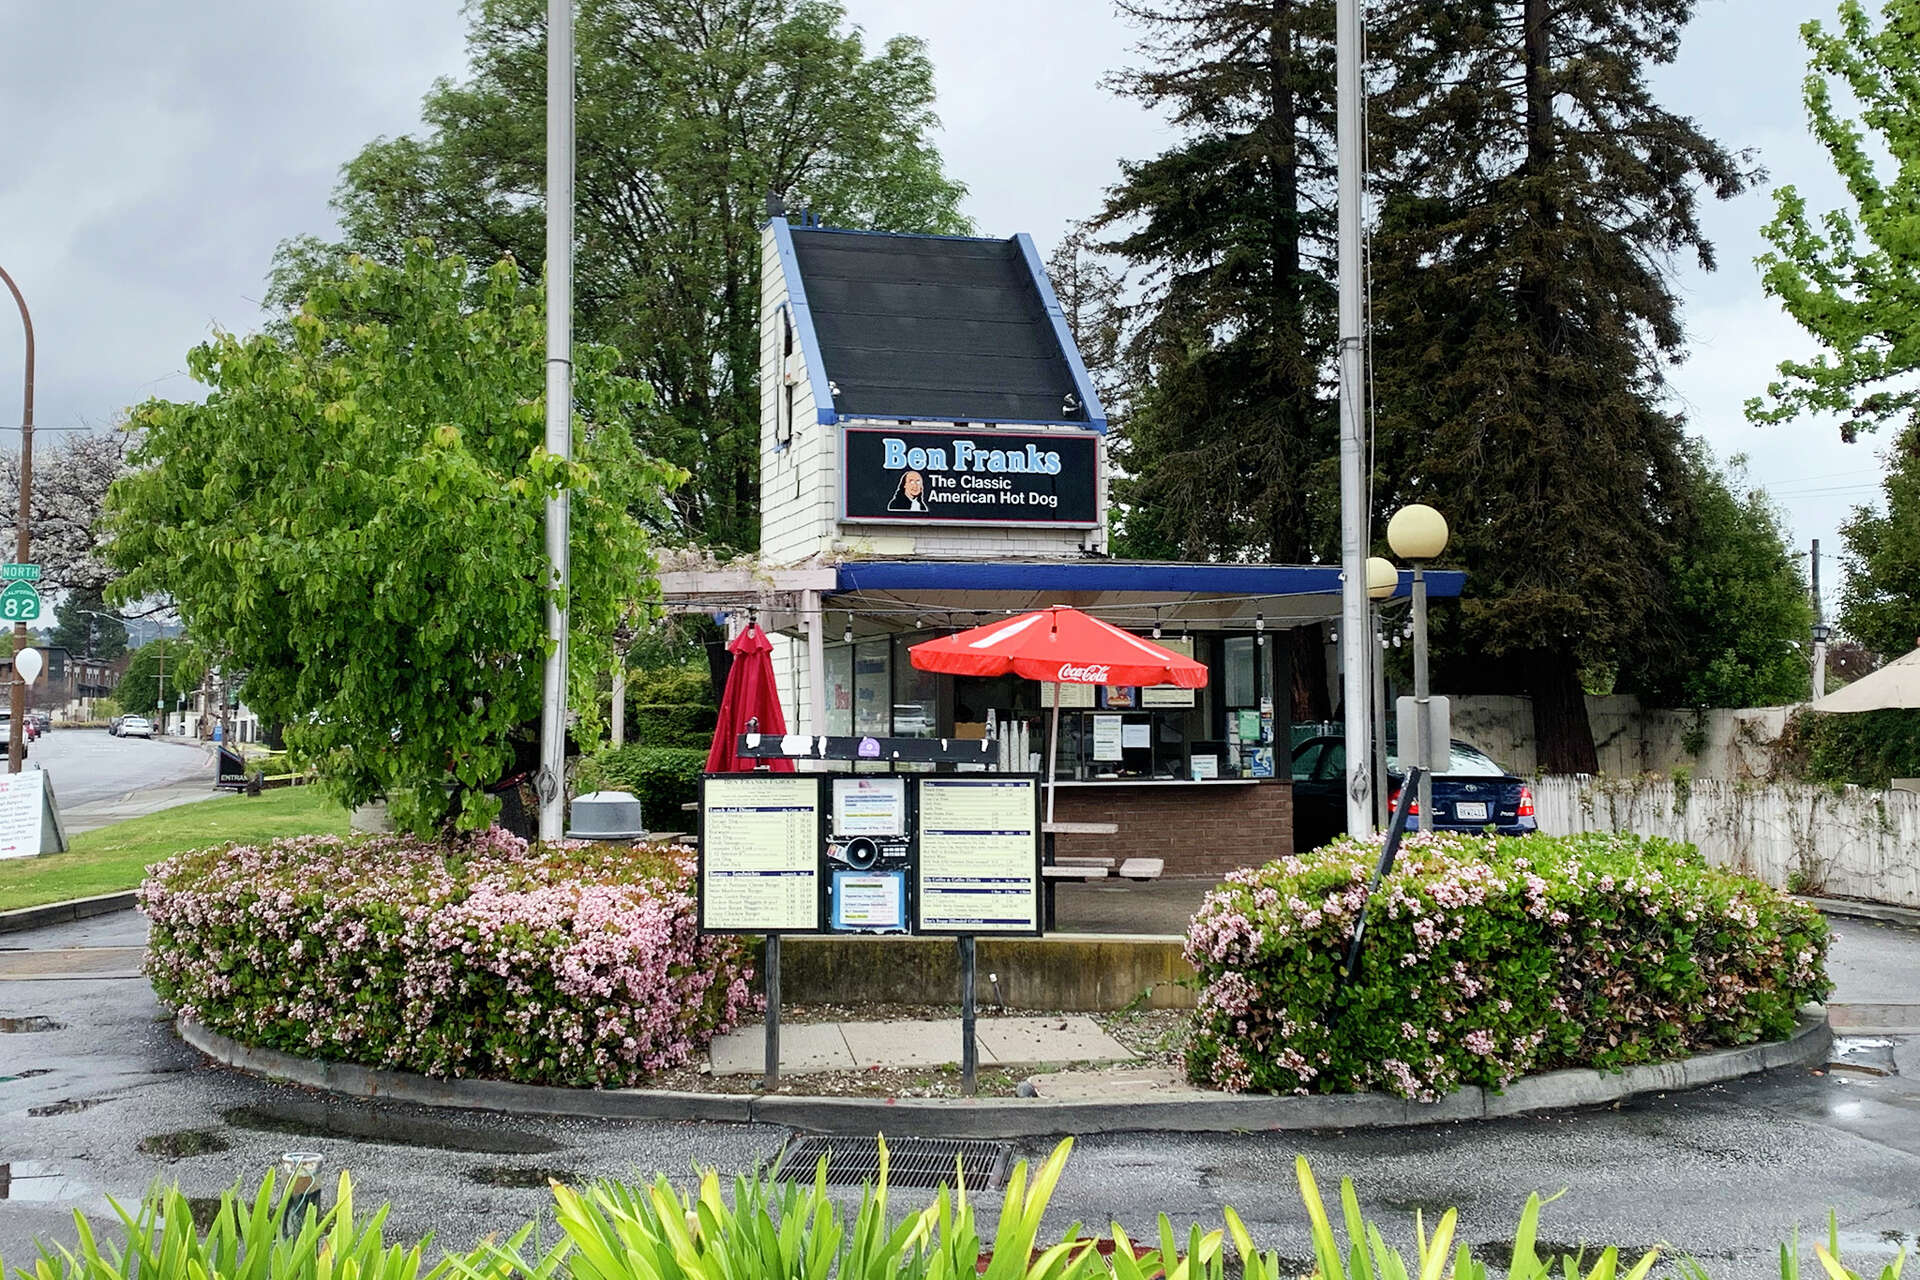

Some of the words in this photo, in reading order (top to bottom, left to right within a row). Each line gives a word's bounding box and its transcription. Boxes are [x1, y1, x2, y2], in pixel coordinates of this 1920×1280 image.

[883, 438, 949, 471] Ben
[953, 440, 1062, 475] Franks
[929, 475, 957, 488] The
[960, 475, 1012, 490] Classic
[928, 490, 995, 504] American
[1000, 491, 1025, 504] Hot
[1029, 492, 1058, 508] Dog
[3, 566, 39, 577] NORTH
[4, 598, 35, 617] 82
[1057, 663, 1111, 682] Coca-Cola
